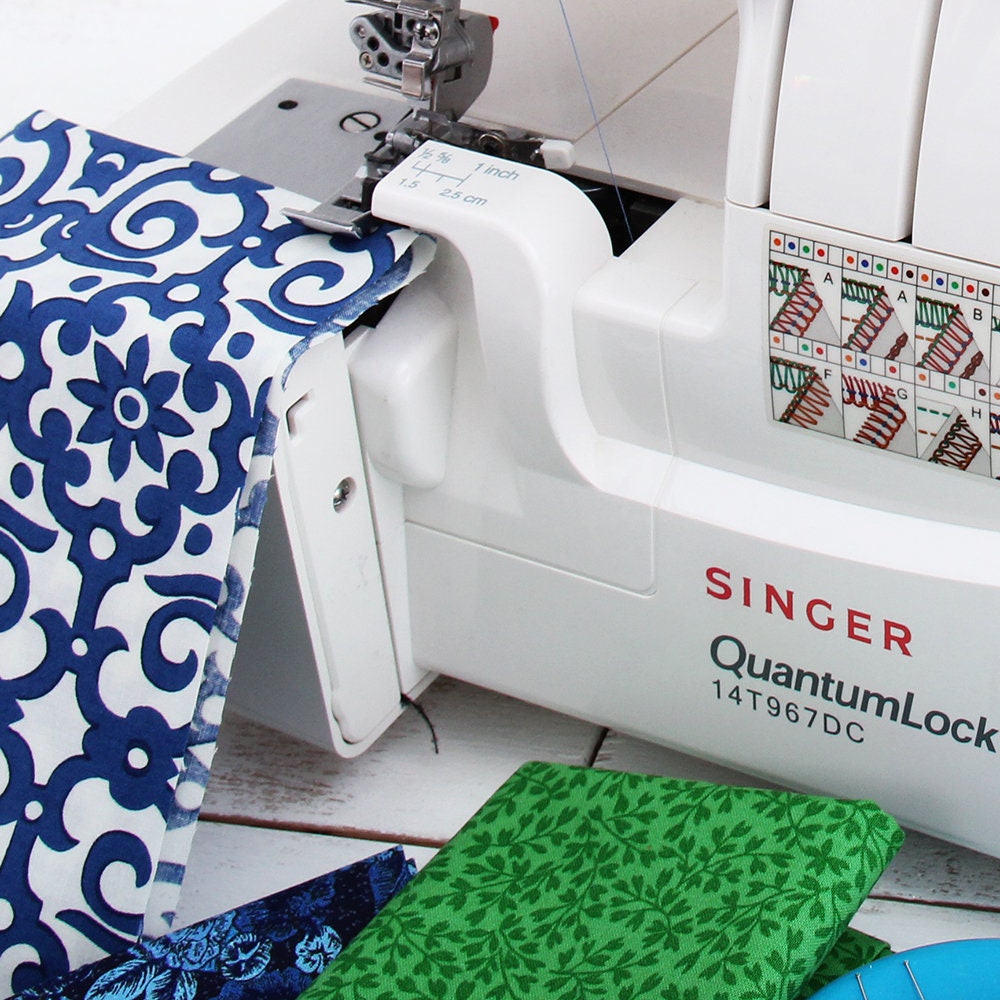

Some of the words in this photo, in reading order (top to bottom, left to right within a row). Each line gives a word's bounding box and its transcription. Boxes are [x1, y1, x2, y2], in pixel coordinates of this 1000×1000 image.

[474, 162, 485, 171] 1
[484, 164, 519, 181] inch
[399, 177, 420, 189] 1.5
[439, 188, 463, 200] 2.5
[463, 194, 488, 206] cm
[823, 272, 834, 285] A
[897, 290, 908, 303] A
[973, 308, 983, 321] B
[824, 369, 832, 379] F
[896, 388, 908, 400] G
[971, 407, 982, 419] H
[705, 566, 913, 657] SINGER
[710, 634, 1000, 753] QuantumLock
[712, 679, 865, 744] 14T967DC
